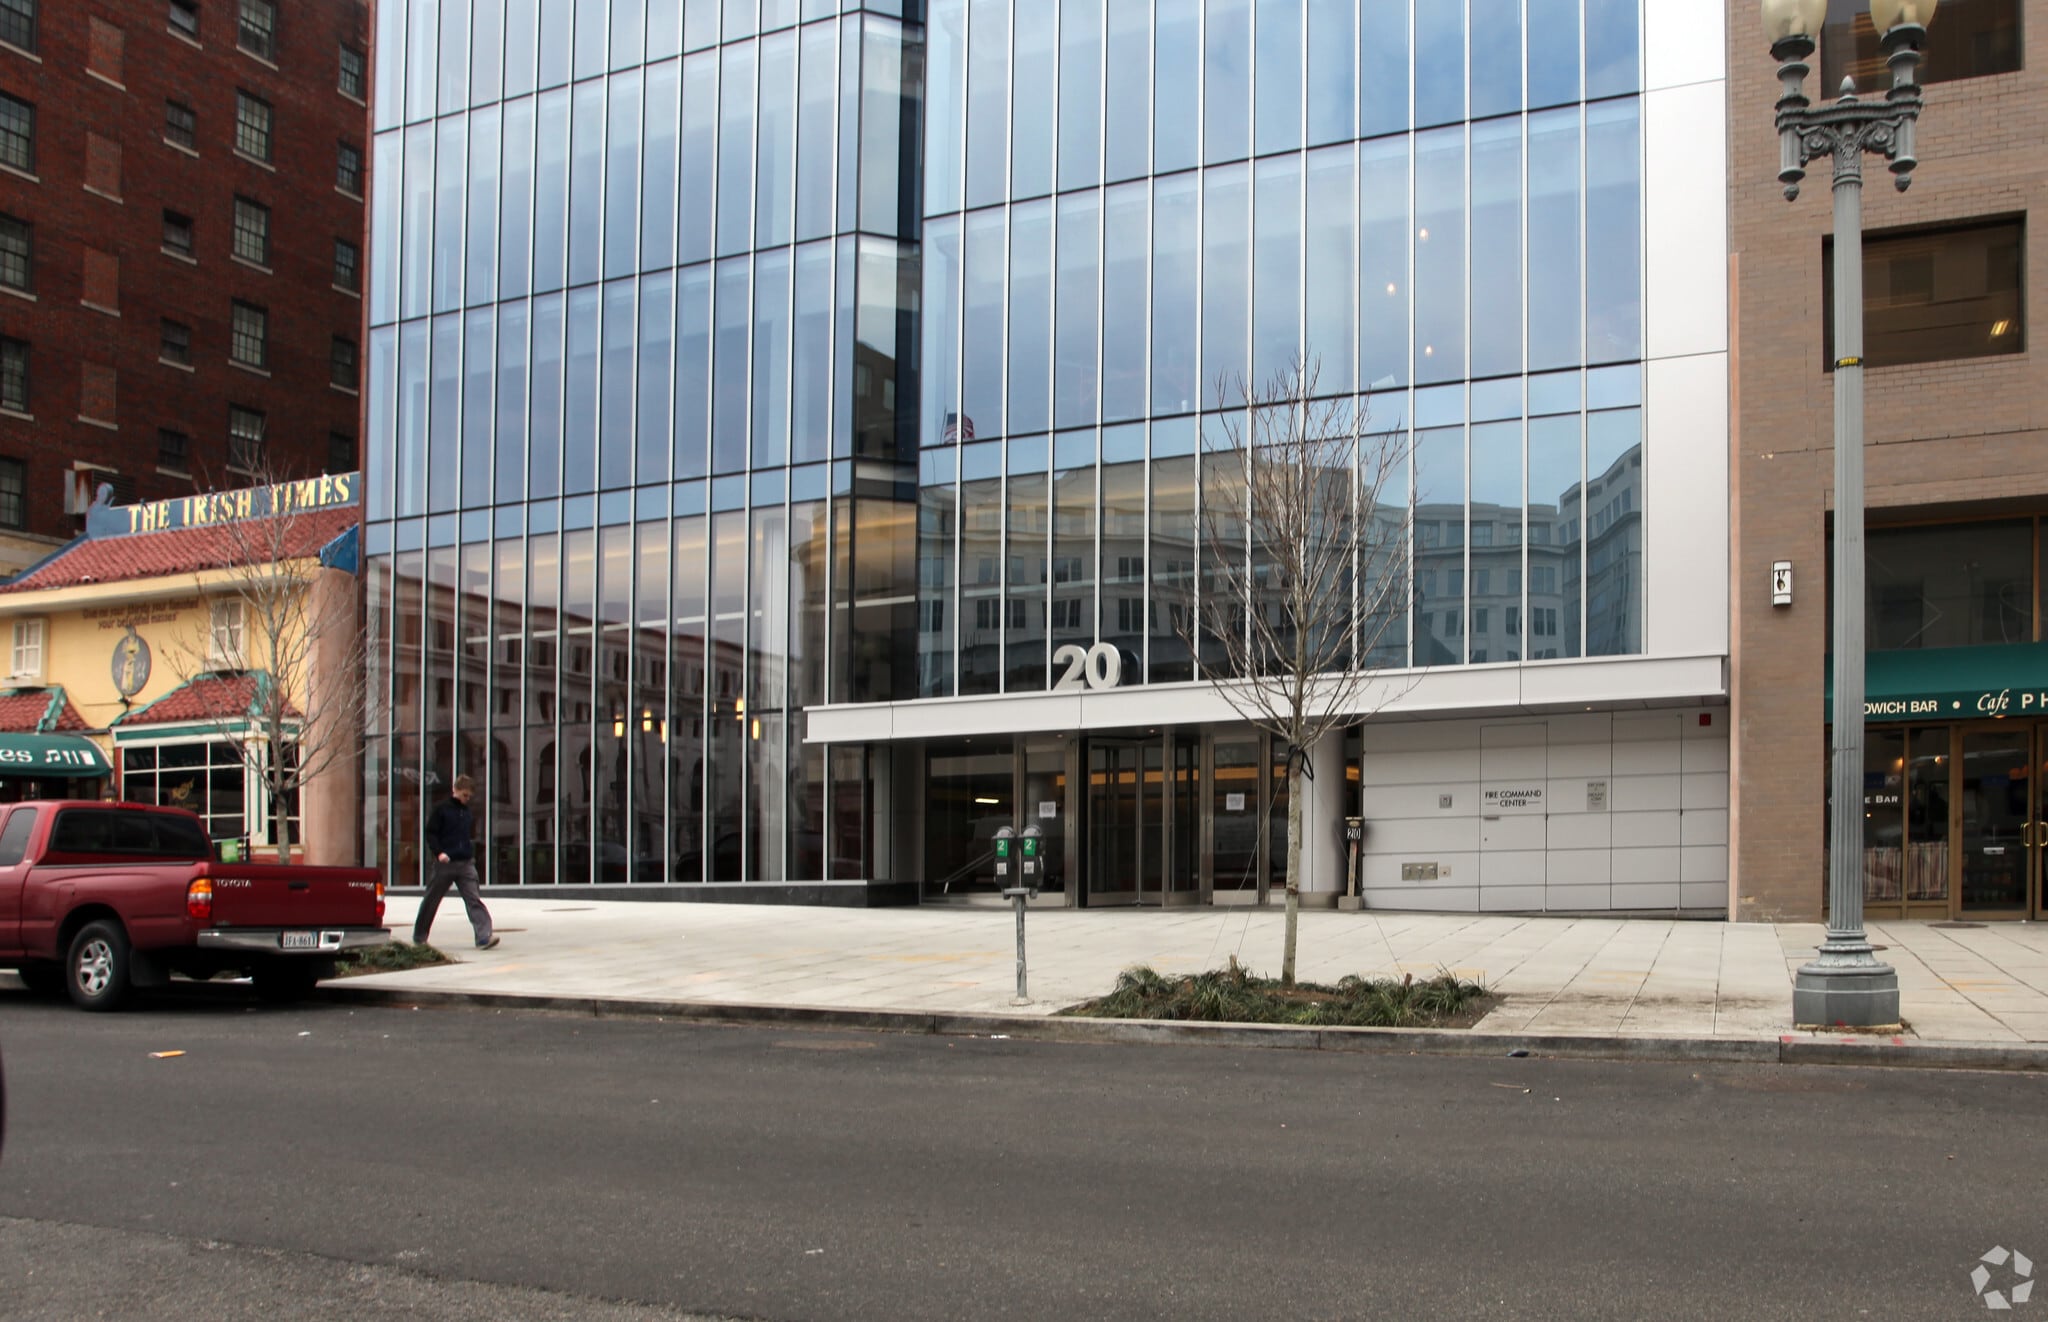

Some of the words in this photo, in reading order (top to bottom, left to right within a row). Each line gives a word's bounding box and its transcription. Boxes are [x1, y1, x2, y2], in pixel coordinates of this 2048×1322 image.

[128, 501, 171, 534] THE
[182, 491, 252, 527] IRISH
[271, 475, 350, 514] TIMES
[1051, 642, 1121, 692] 20
[1864, 701, 1906, 715] DWICH
[1911, 700, 1938, 713] BAR
[1485, 791, 1498, 799] FIRE
[1500, 789, 1542, 799] COMMAND
[1500, 799, 1527, 807] CENTER
[997, 840, 1005, 851] 2
[1025, 838, 1032, 850] 2
[216, 879, 251, 888] TOYOTA
